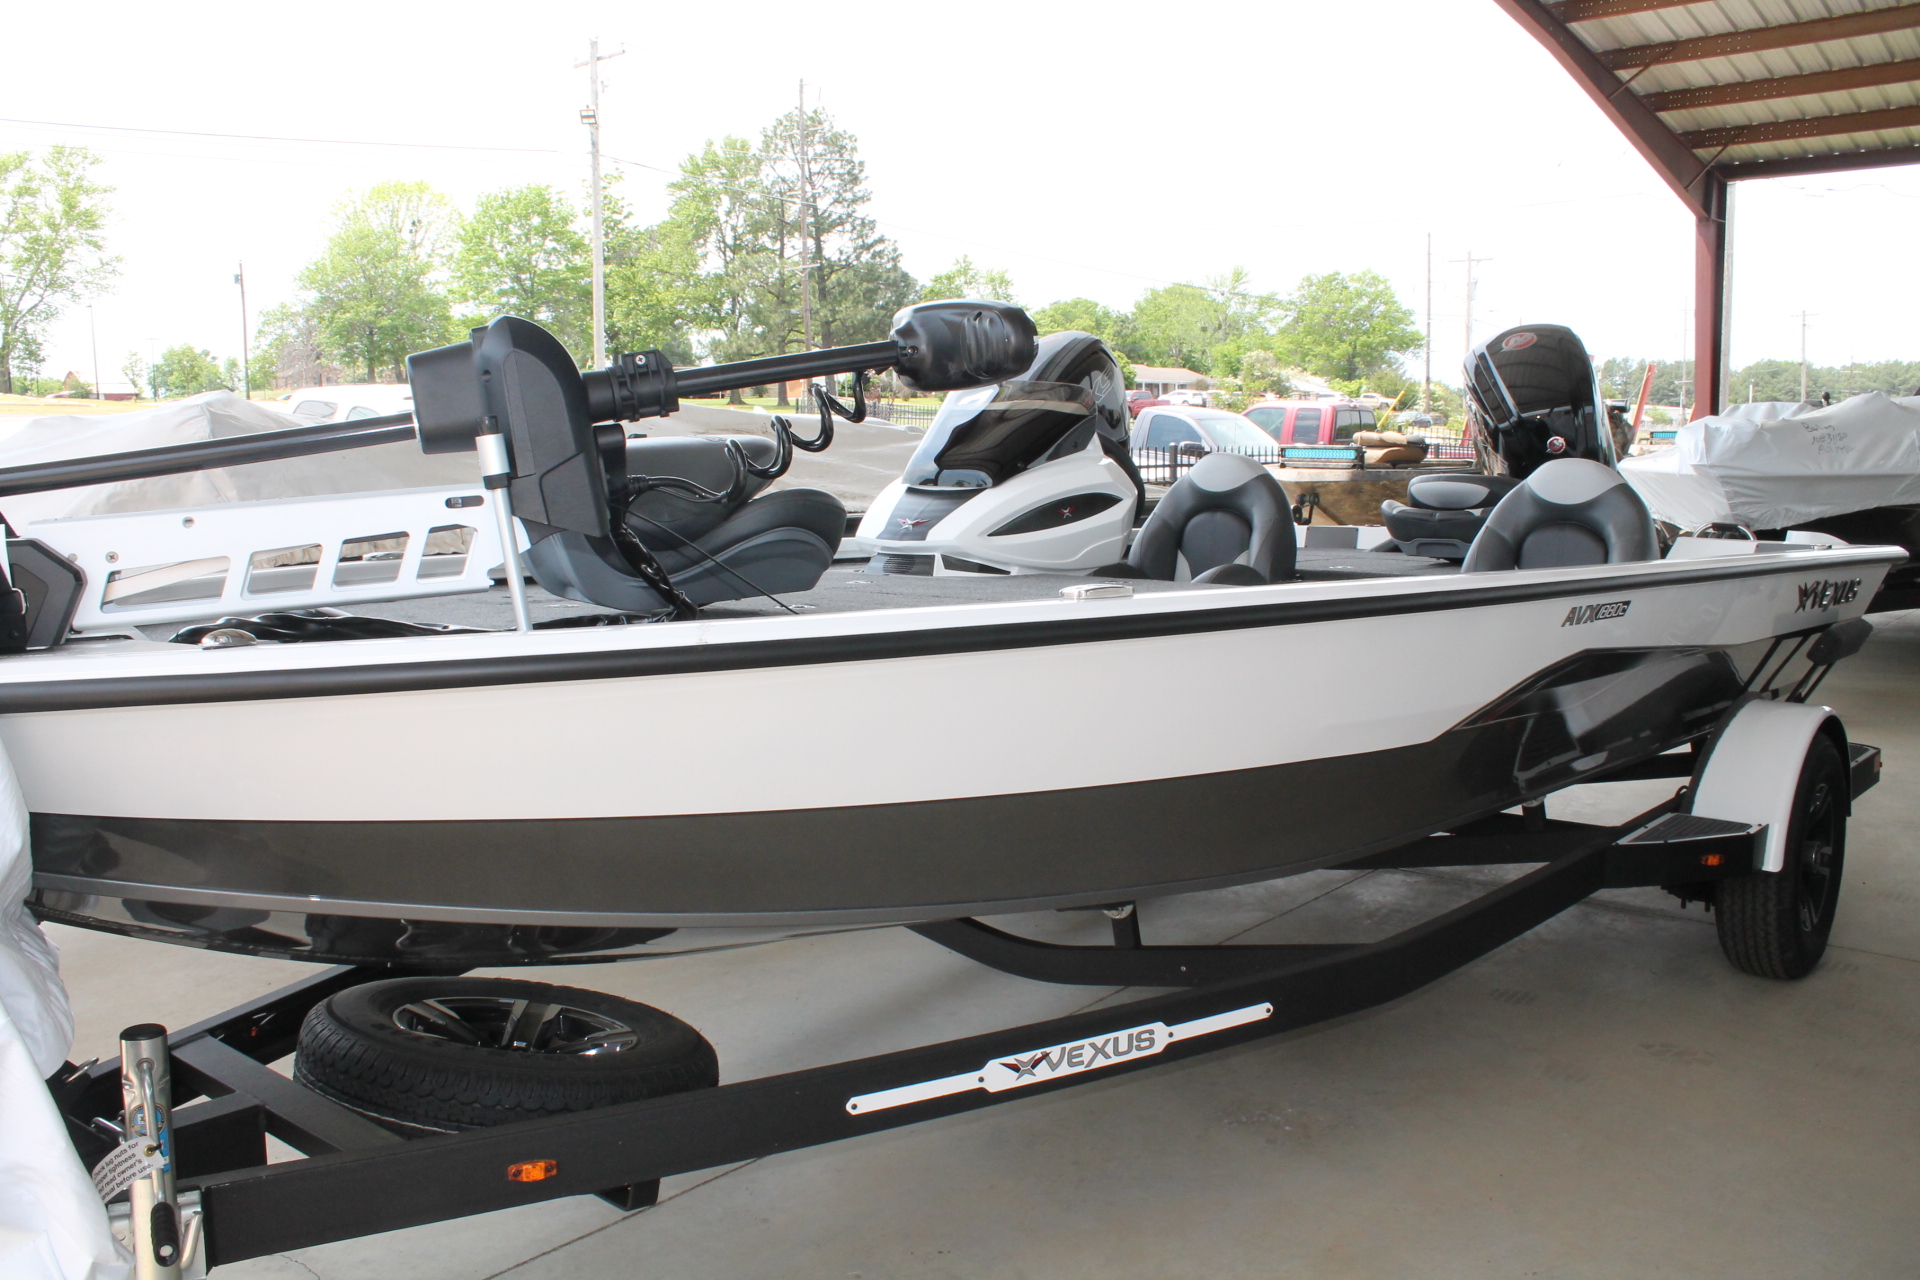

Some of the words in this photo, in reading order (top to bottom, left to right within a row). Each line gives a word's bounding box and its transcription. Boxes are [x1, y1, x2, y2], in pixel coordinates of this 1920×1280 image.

[1040, 1028, 1156, 1072] VEXUS
[105, 1158, 114, 1167] lug
[114, 1149, 128, 1160] nuts
[128, 1141, 139, 1150] for
[108, 1152, 136, 1174] tightness
[105, 1175, 117, 1188] read
[117, 1158, 143, 1177] owner's
[116, 1171, 137, 1188] before
[138, 1162, 154, 1174] use.
